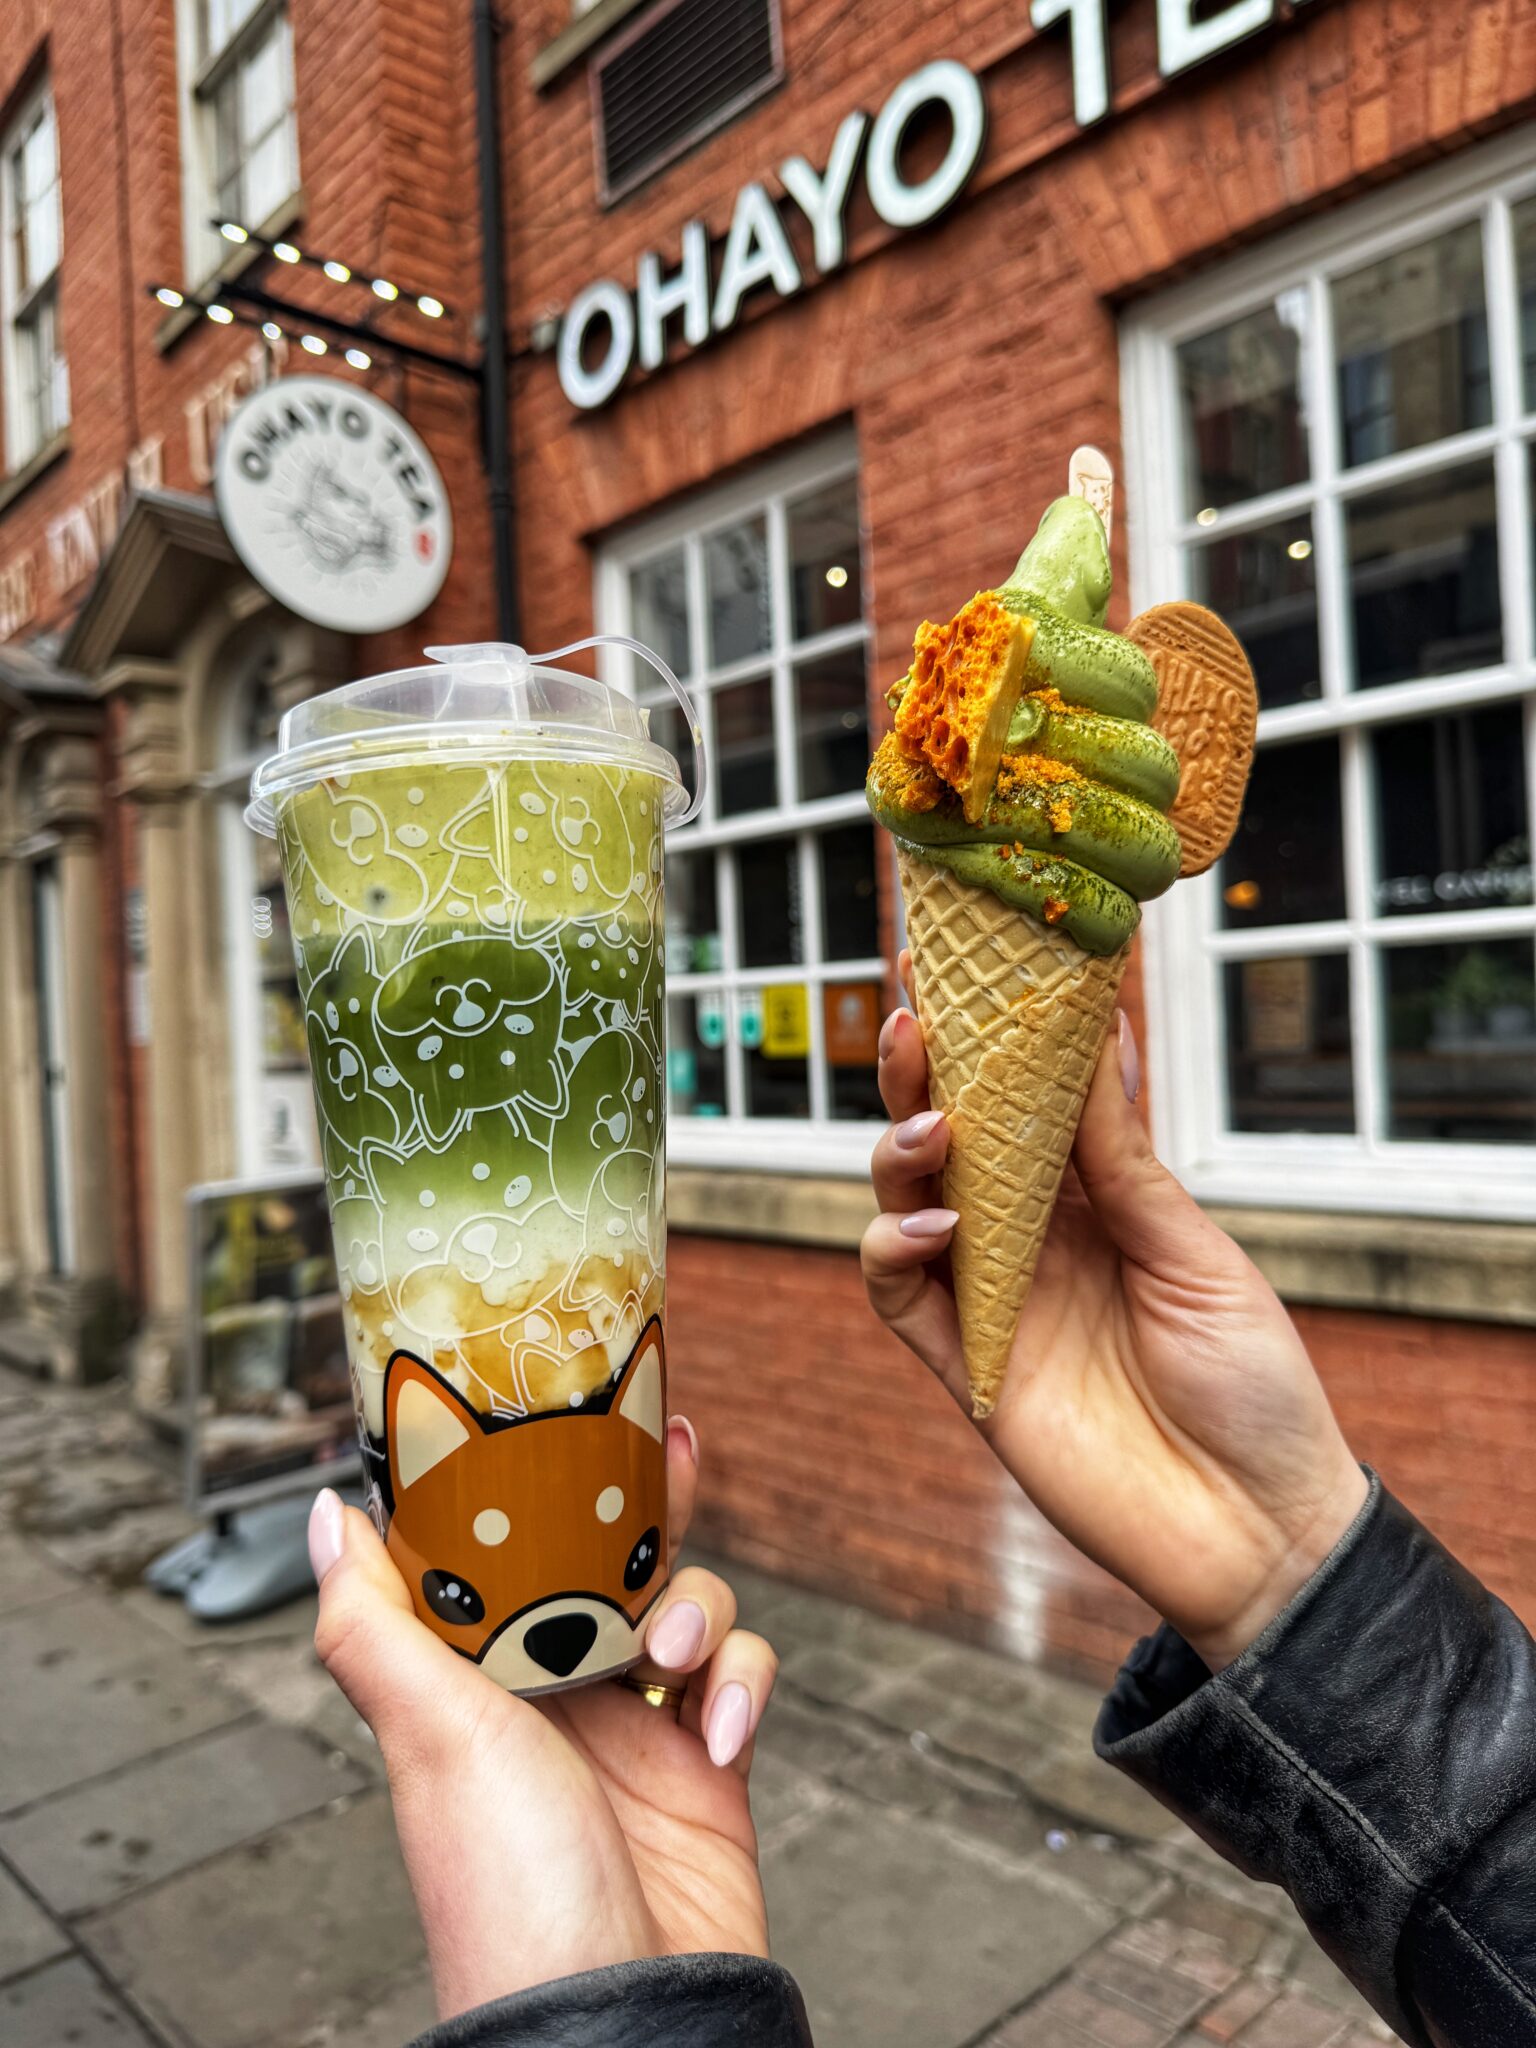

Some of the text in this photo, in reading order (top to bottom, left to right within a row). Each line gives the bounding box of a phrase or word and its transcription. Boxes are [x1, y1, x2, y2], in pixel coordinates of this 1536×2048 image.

[557, 58, 984, 409] OHAYO
[237, 391, 371, 482] OHAYO
[378, 429, 435, 523] TEA
